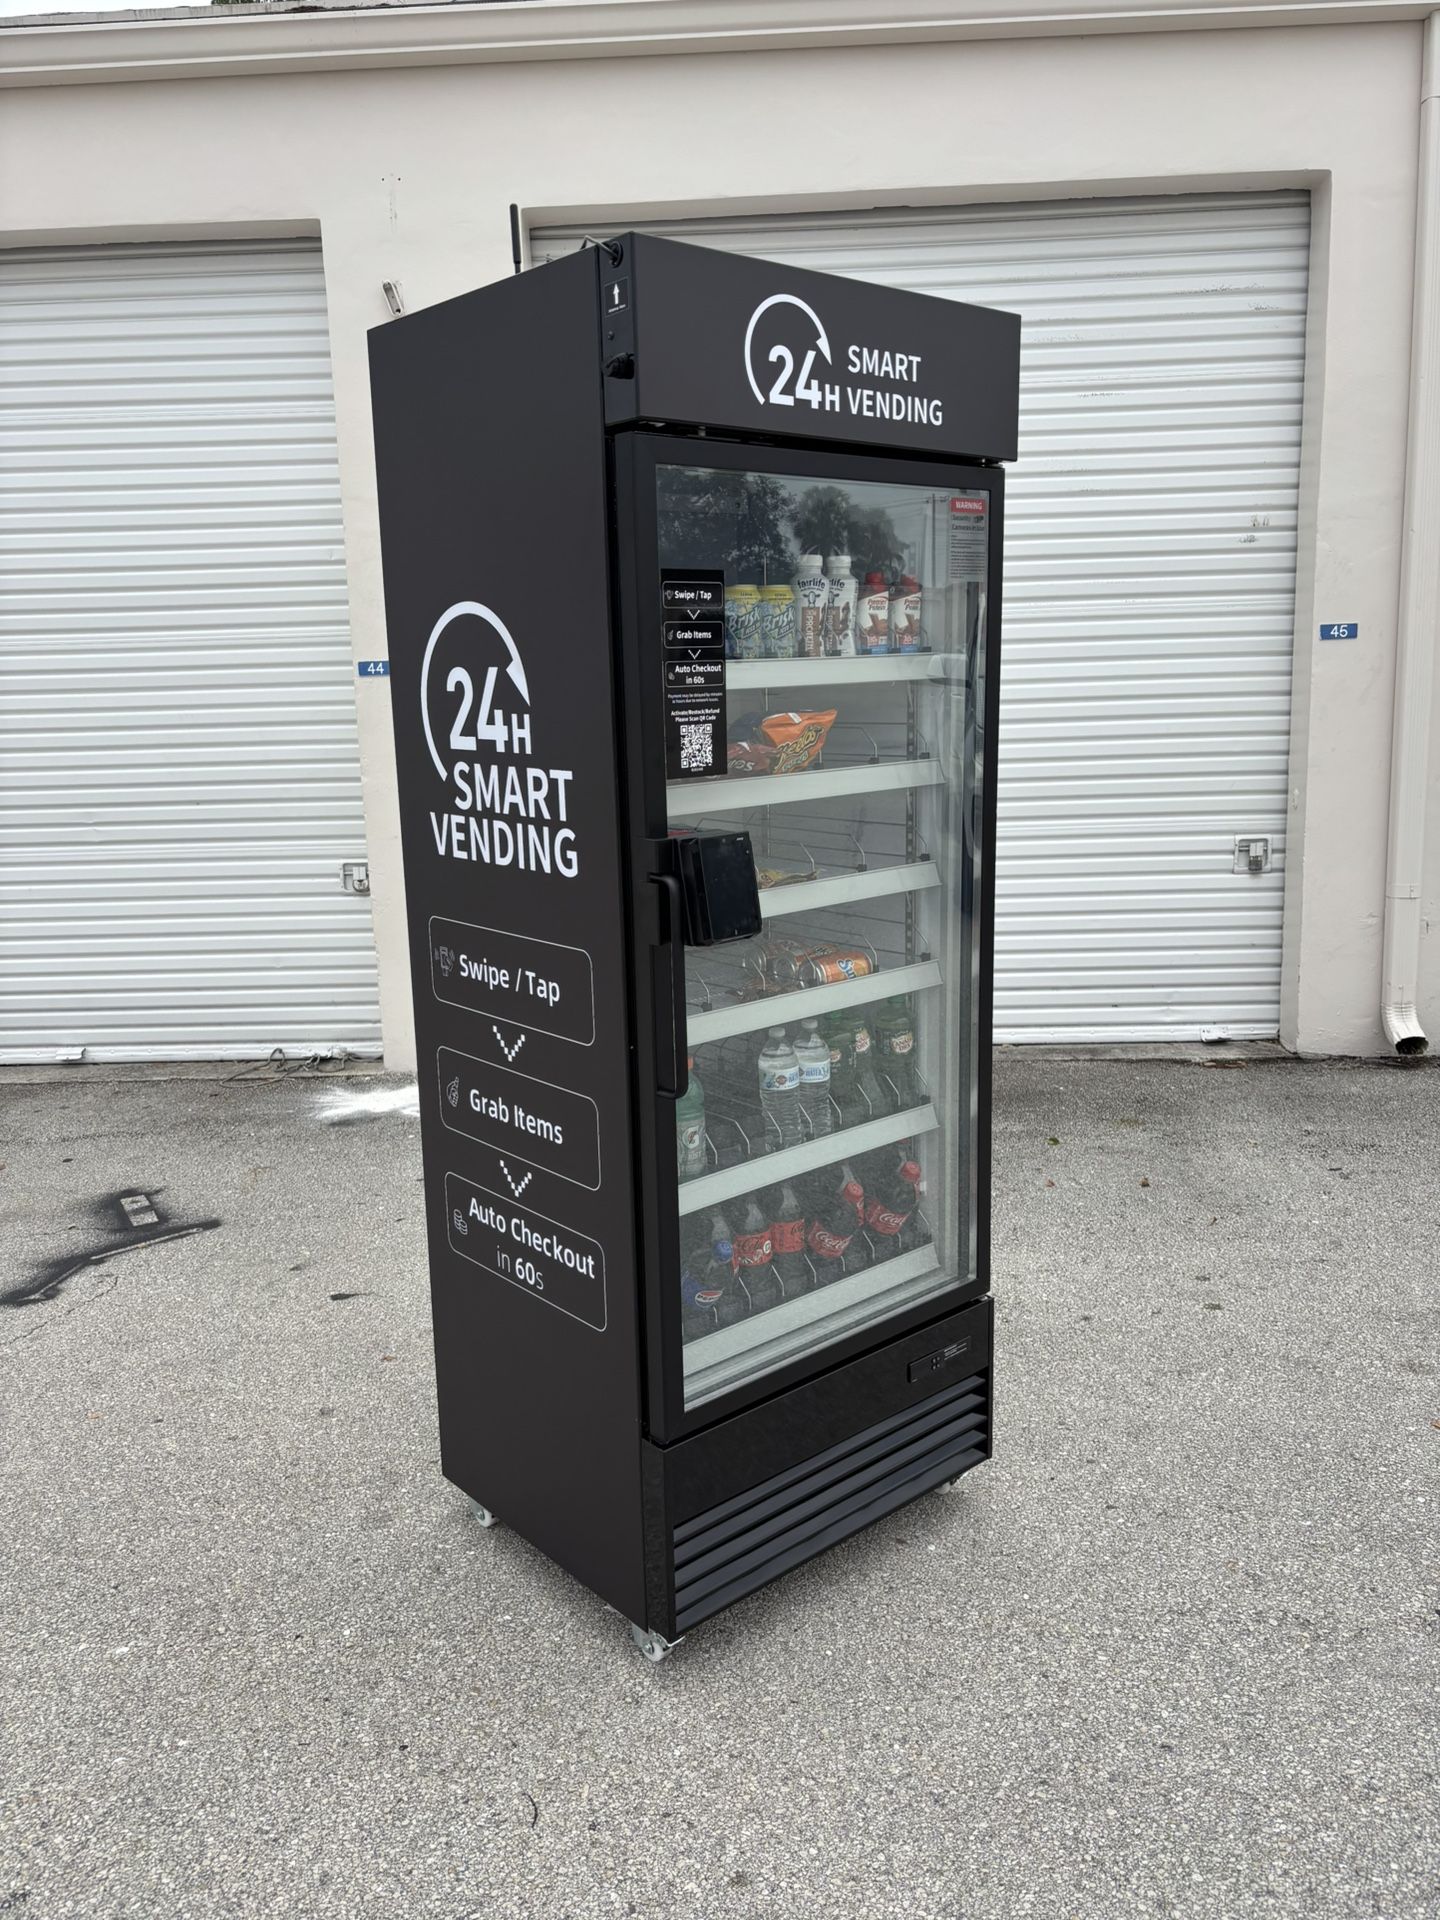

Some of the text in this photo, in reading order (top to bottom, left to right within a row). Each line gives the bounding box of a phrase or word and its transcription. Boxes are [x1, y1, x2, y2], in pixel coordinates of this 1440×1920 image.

[848, 345, 922, 383] SMART
[847, 386, 943, 426] VENDING
[955, 501, 983, 510] WARNING
[674, 590, 695, 600] Swipe
[700, 590, 712, 600] Tap
[797, 578, 826, 589] fairlife
[676, 630, 712, 639] Grab Items
[1330, 624, 1348, 637] 45
[367, 662, 384, 674] 44
[675, 664, 722, 673] Auto Checkout
[685, 676, 705, 684] in 60s
[453, 761, 573, 821] SMART
[429, 811, 578, 878] VENDING
[459, 954, 561, 1006] Swipe / Tap
[470, 1088, 563, 1145] Grab Items
[469, 1197, 595, 1279] Auto Checkout
[496, 1245, 544, 1291] in 60s
